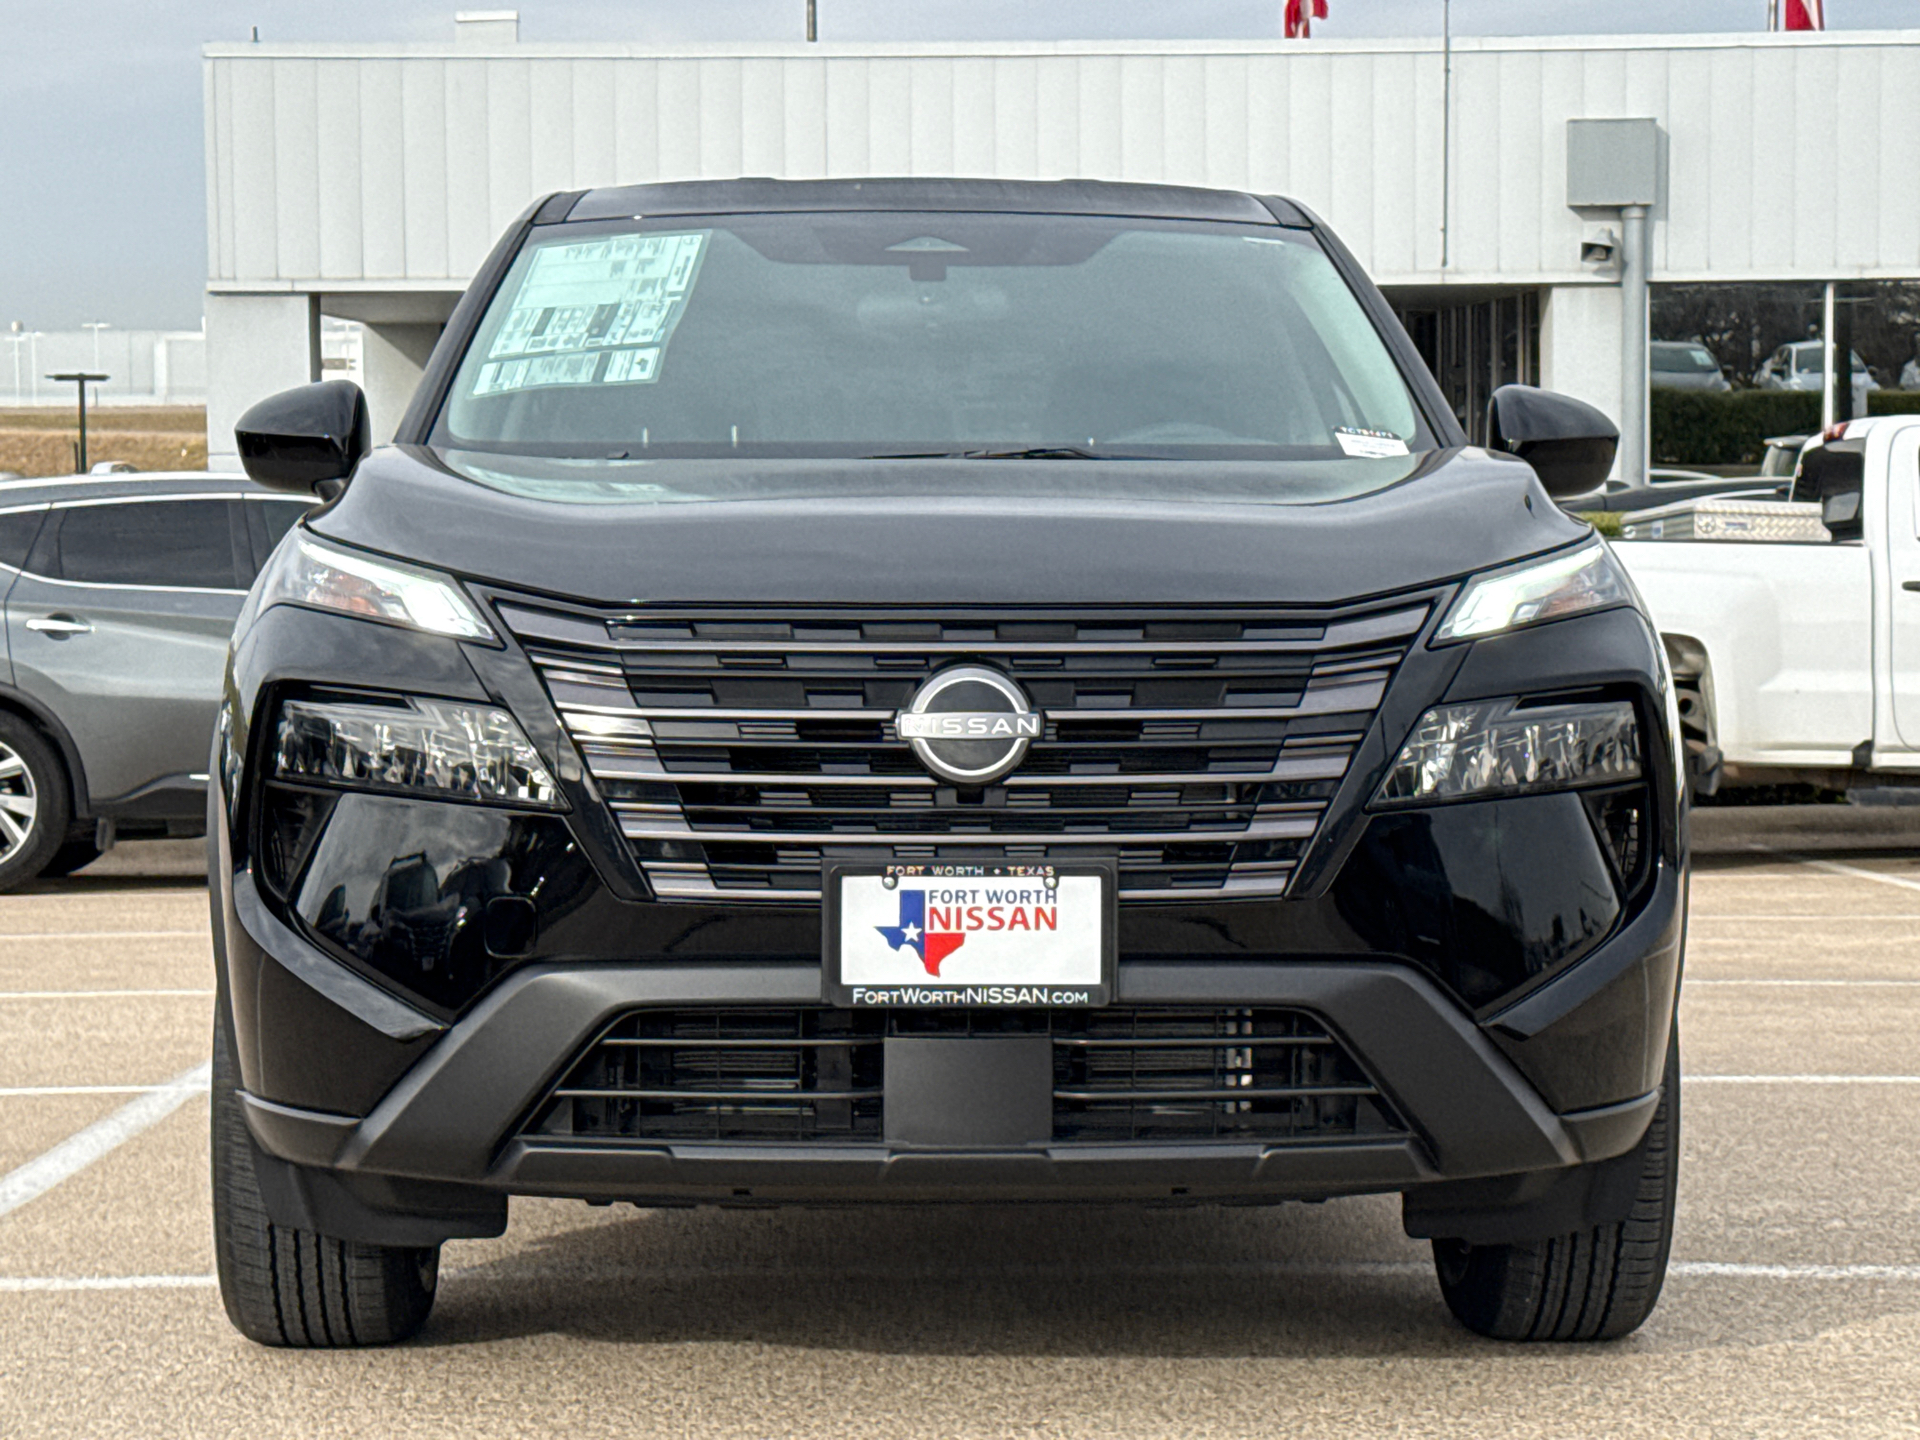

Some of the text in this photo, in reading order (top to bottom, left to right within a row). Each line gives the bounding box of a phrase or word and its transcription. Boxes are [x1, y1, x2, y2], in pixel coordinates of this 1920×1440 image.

[904, 716, 1037, 734] NISSAN
[887, 866, 1055, 876] FORT WORTH TEXAS
[928, 890, 1057, 904] FORT WORTH
[928, 907, 1057, 930] NISSAN
